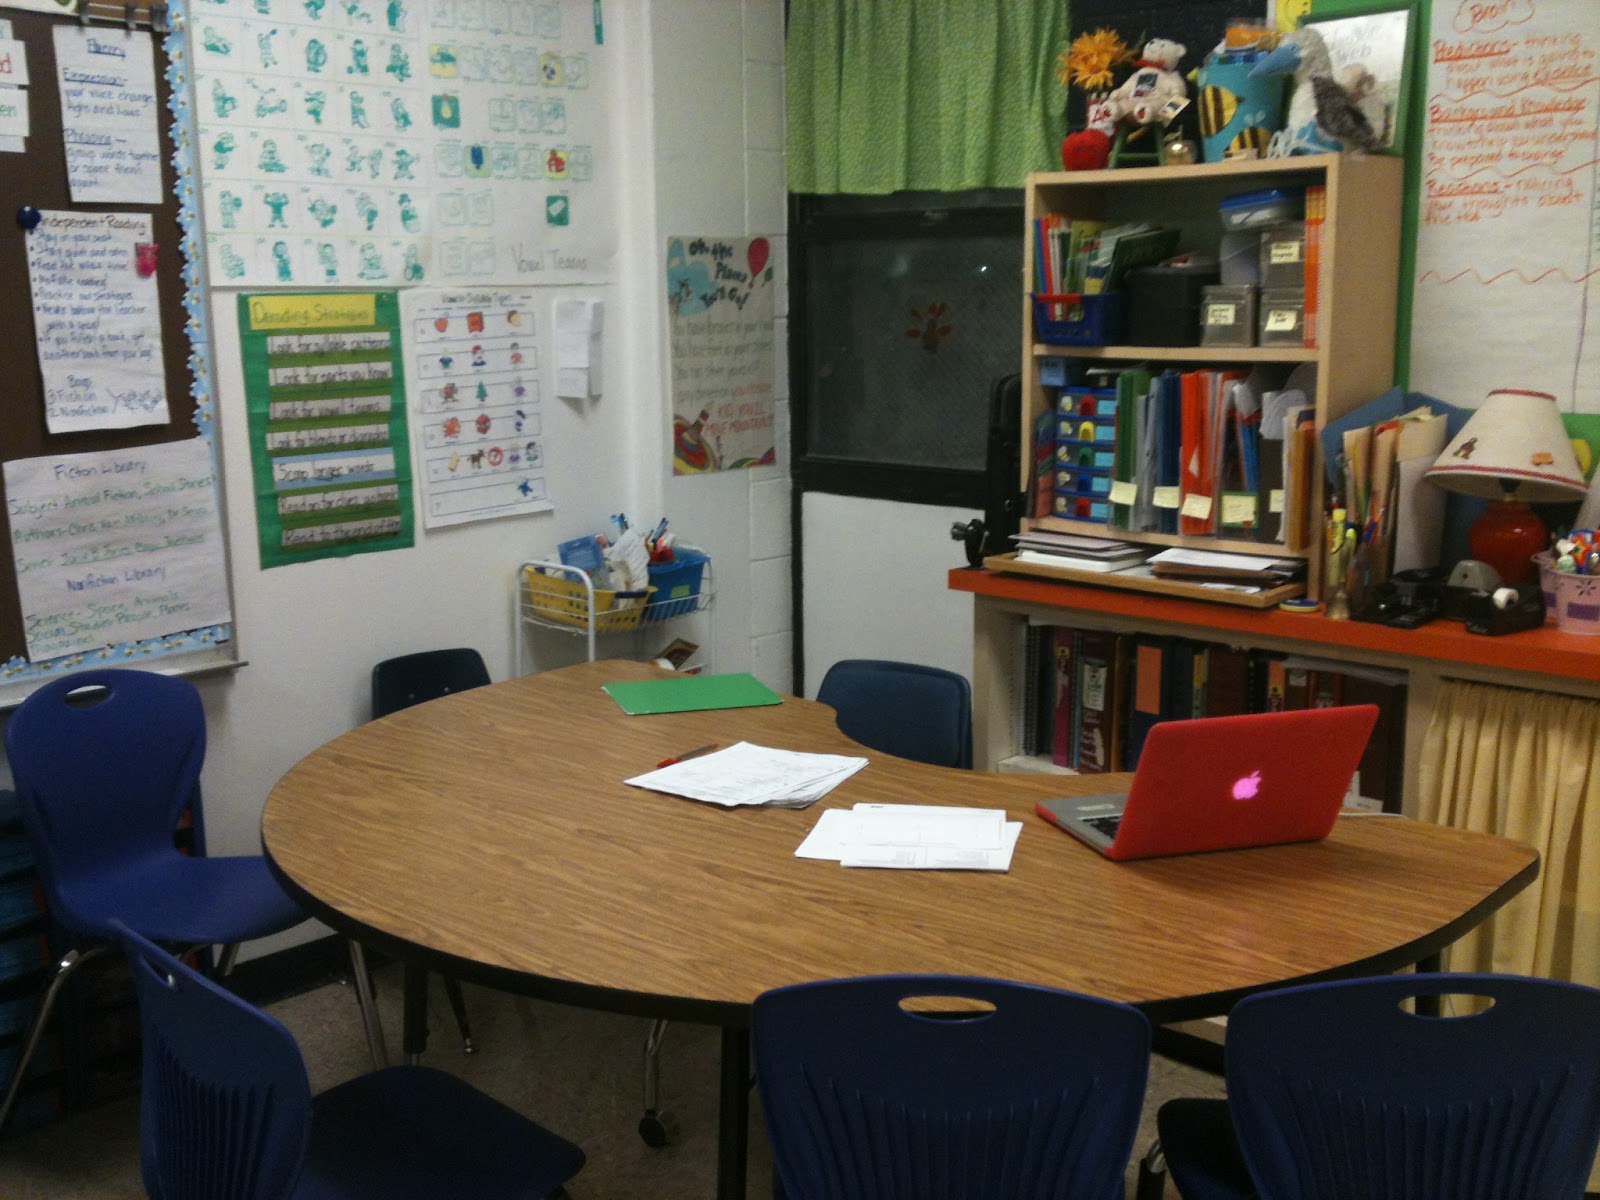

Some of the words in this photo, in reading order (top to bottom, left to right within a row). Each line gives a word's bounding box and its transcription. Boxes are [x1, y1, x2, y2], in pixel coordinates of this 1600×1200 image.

[53, 464, 97, 481] Fiction
[102, 460, 147, 479] Library
[125, 566, 166, 583] Library
